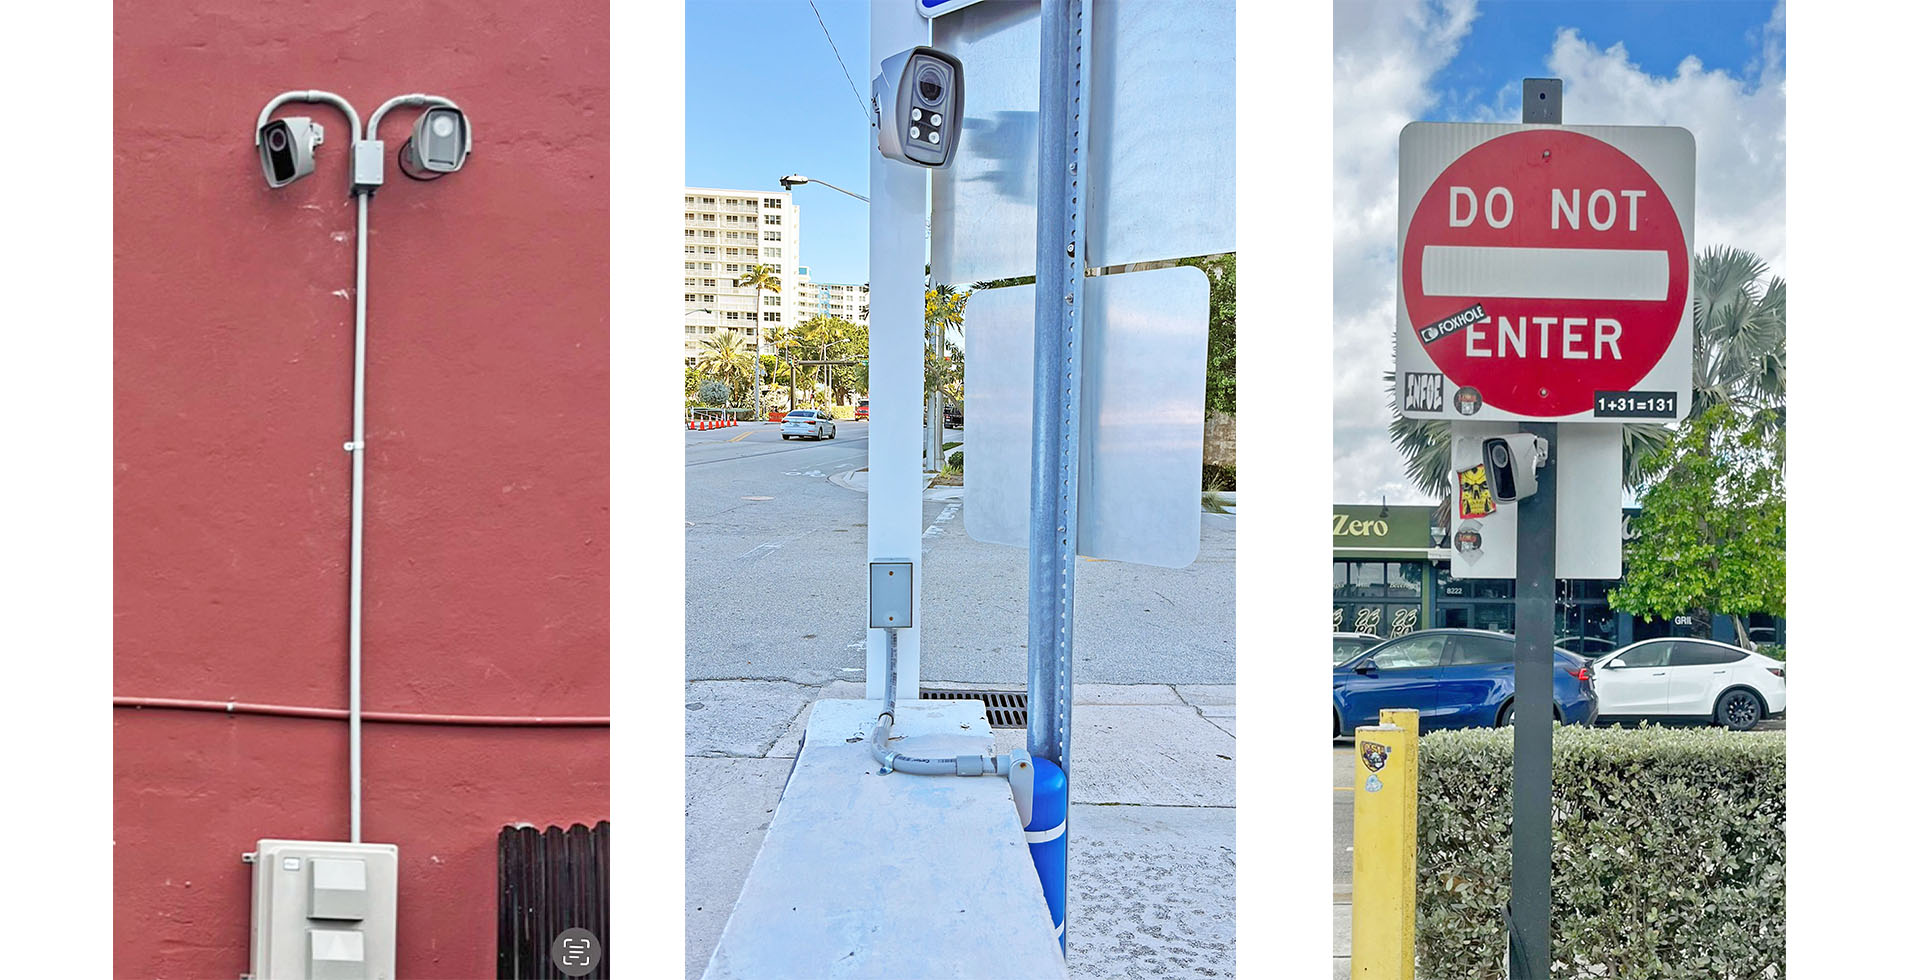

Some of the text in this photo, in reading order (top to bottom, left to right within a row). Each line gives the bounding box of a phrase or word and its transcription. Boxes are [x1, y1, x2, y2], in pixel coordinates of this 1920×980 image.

[1449, 186, 1647, 231] DO NOT
[1438, 306, 1484, 334] FOXHOLE
[1465, 316, 1623, 360] ENTER
[1597, 398, 1674, 411] 1+31=131
[1333, 514, 1389, 537] Zero
[1446, 587, 1463, 595] 8222
